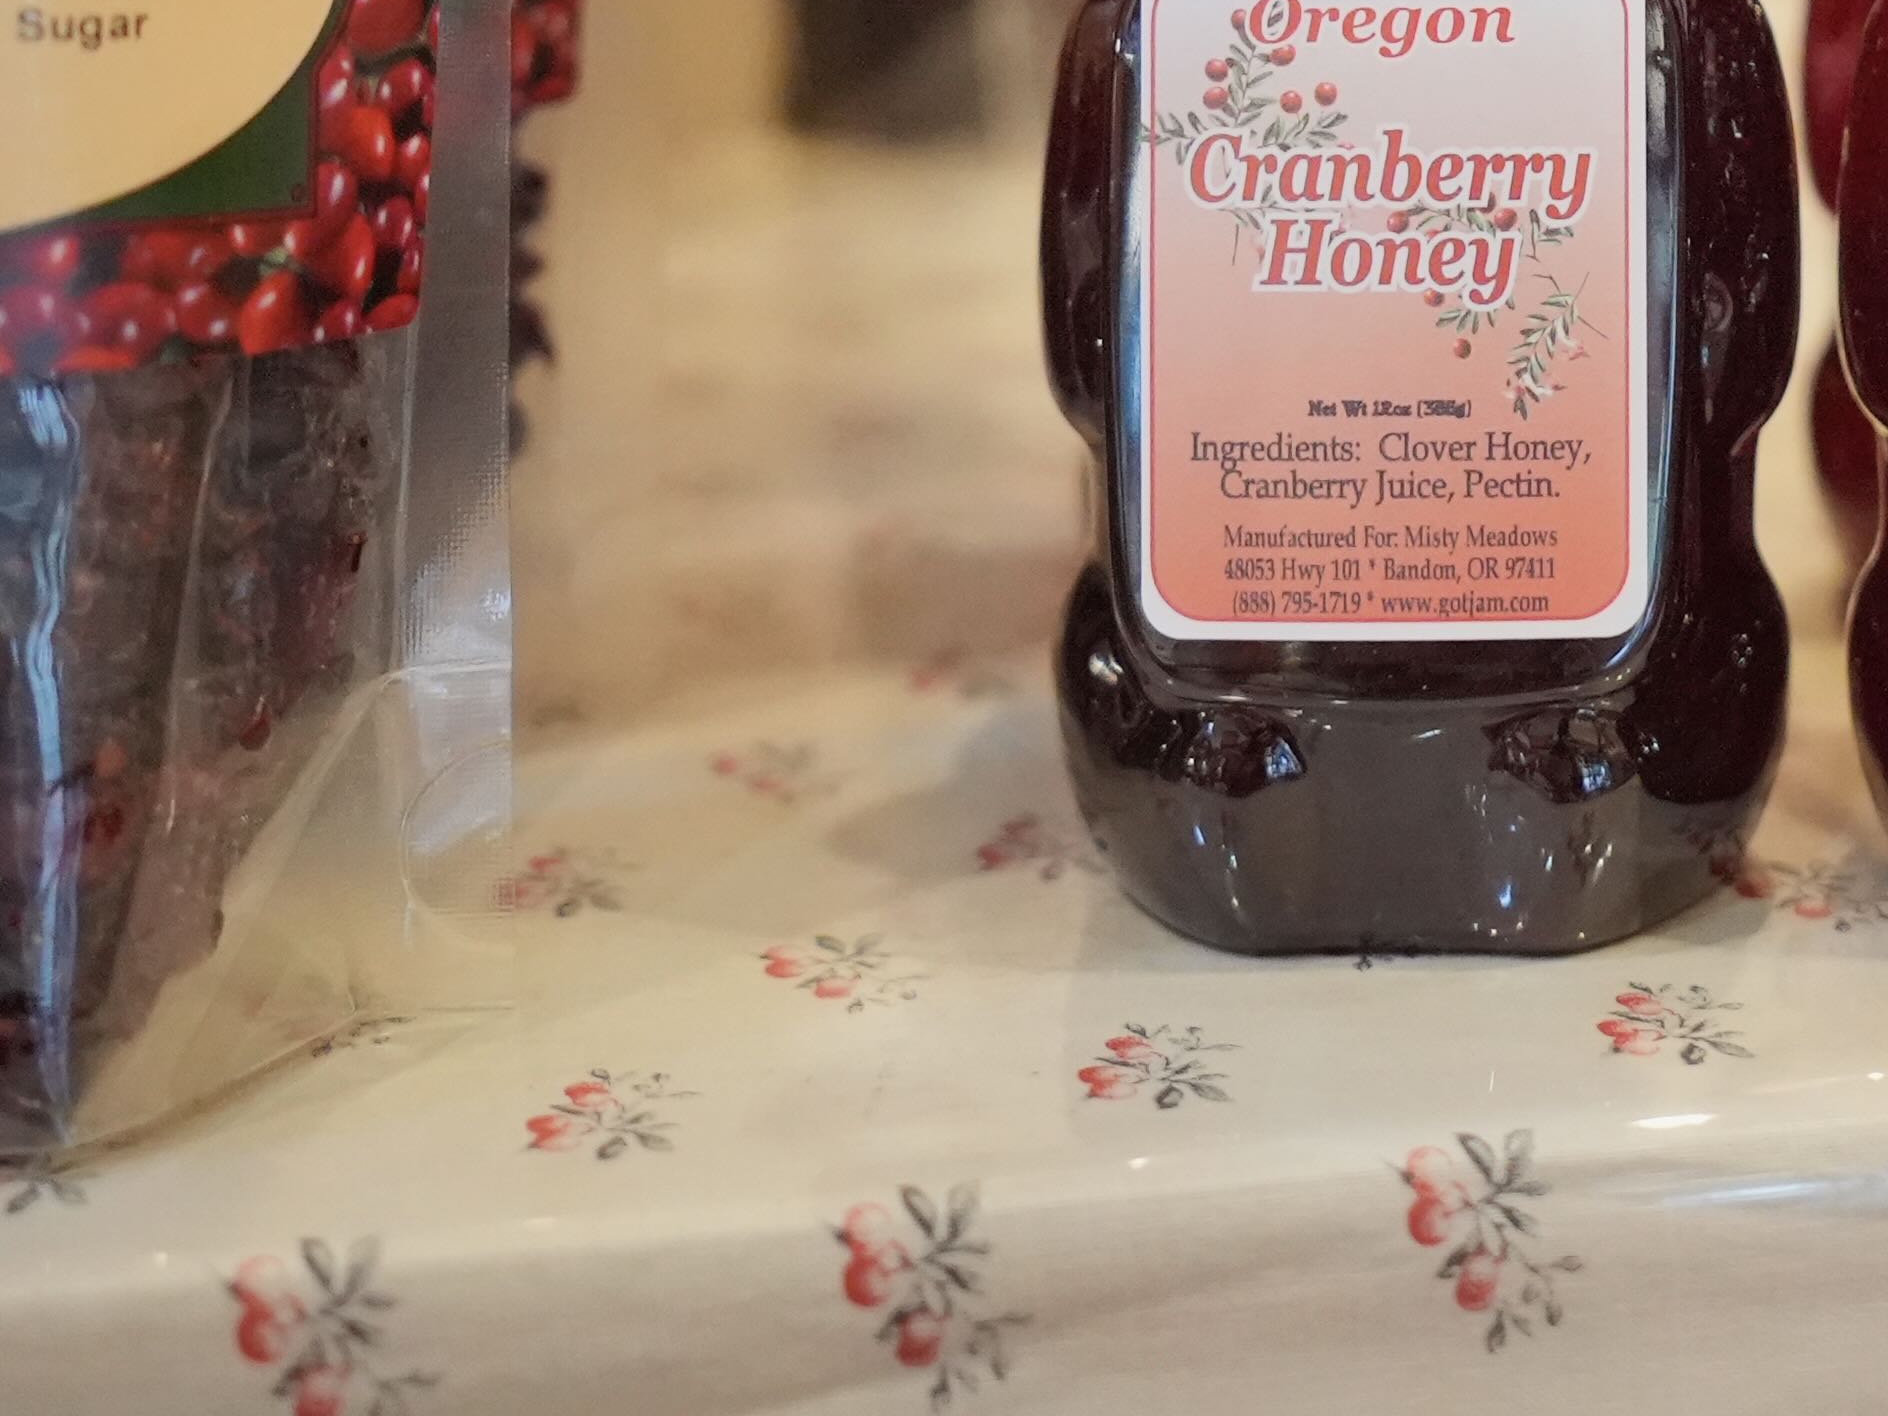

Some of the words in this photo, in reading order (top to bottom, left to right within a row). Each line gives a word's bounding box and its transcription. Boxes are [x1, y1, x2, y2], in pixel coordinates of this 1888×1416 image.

[17, 7, 148, 51] Sugar
[1189, 129, 1592, 219] Cranberry
[1260, 218, 1518, 305] Honey
[1307, 399, 1337, 417] Net
[1341, 399, 1367, 417] Wt
[1190, 432, 1361, 471] Ingredients:
[1378, 431, 1475, 462] Clover
[1484, 432, 1592, 466] Honey,
[1220, 469, 1368, 508] Cranberry
[1375, 470, 1455, 505] Juice,
[1464, 469, 1561, 499] Pectin.
[1223, 525, 1357, 549] Manufactured
[1363, 525, 1398, 548] For:
[1405, 524, 1459, 555] Misty
[1466, 524, 1558, 547] Meadows
[1223, 558, 1276, 582] 48053
[1281, 558, 1326, 588] Hwy
[1332, 558, 1361, 581] 101
[1383, 556, 1460, 584] Bandon,
[1467, 557, 1499, 581] OR
[1505, 556, 1556, 580] 97411
[1232, 590, 1277, 616] (888)
[1282, 591, 1361, 614] 795-1719
[1381, 589, 1549, 618] www.gotjam.com
